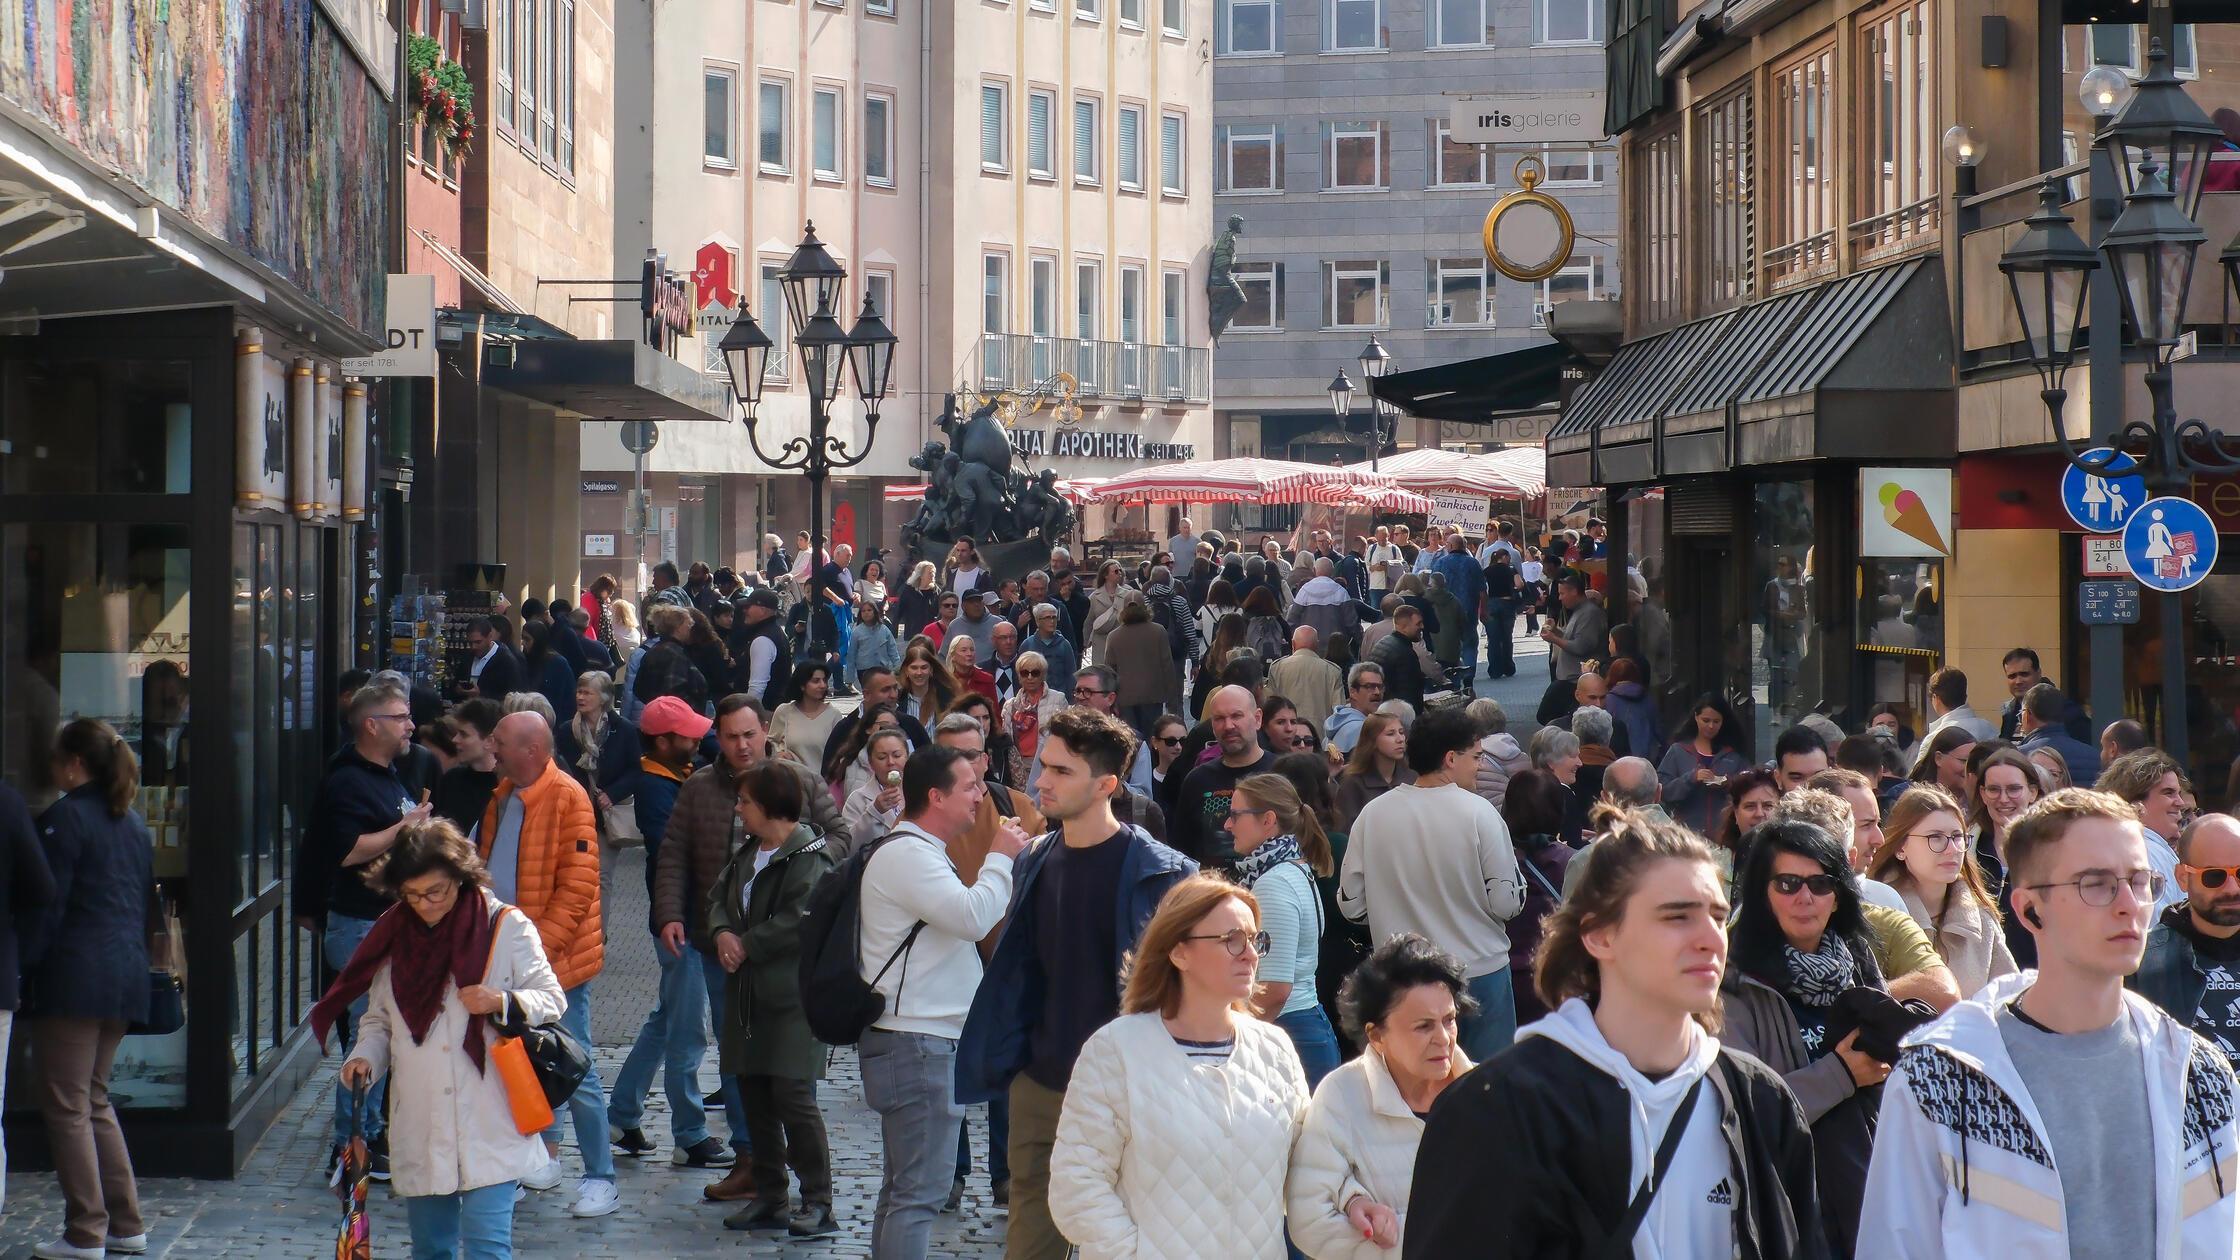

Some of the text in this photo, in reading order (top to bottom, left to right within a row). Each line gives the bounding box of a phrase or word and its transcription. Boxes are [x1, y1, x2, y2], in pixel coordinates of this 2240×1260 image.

[1478, 110, 1581, 132] irisgalerie
[696, 315, 731, 326] ITAL
[388, 329, 424, 349] DT
[358, 358, 374, 367] seit
[1059, 432, 1145, 459] APOTHEKE
[1151, 443, 1170, 459] SEIT
[1174, 444, 1196, 460] 1486
[583, 481, 617, 492] Spitalgasse
[1553, 489, 1583, 499] FRISCHE
[1549, 500, 1574, 510] TRÜF
[2095, 540, 2122, 549] H 80
[2087, 587, 2095, 597] S
[2116, 587, 2124, 597] S
[2207, 980, 2240, 990] didas
[1707, 1194, 1731, 1205] adida
